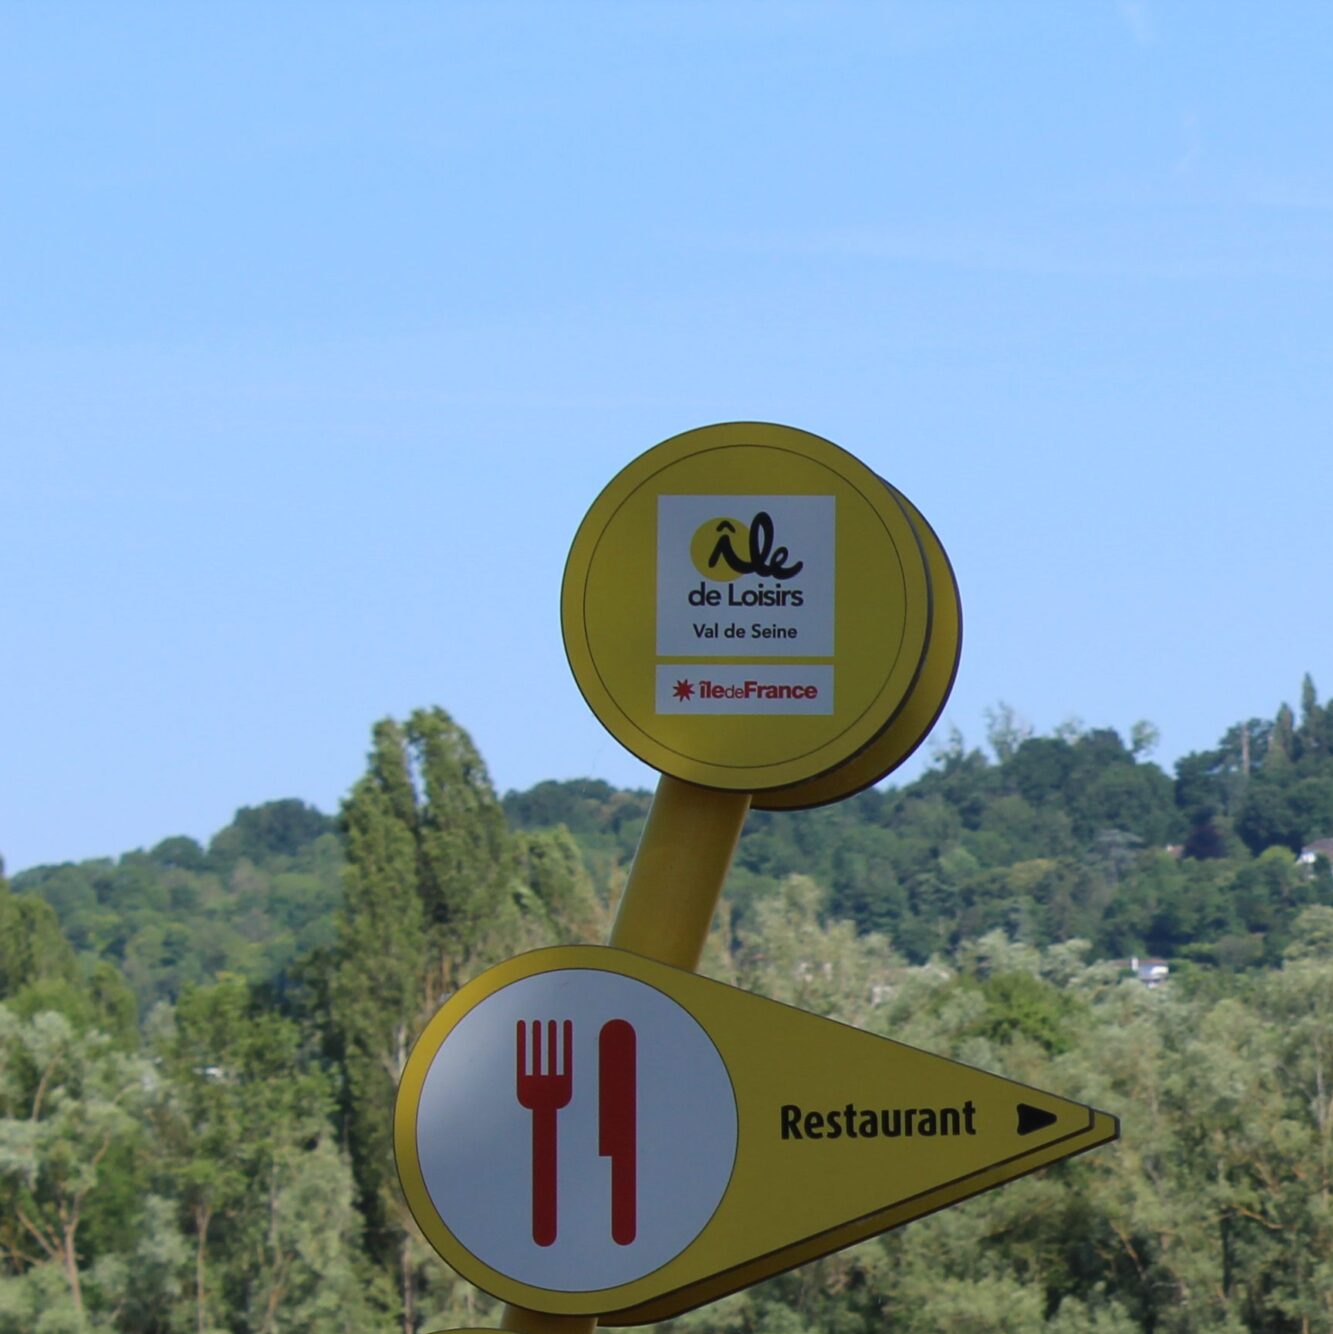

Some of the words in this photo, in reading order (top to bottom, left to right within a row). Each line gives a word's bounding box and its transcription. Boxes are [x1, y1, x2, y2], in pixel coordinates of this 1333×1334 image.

[709, 511, 804, 580] île
[688, 582, 721, 606] de
[729, 583, 804, 607] Loisirs
[693, 623, 719, 639] Val
[724, 623, 746, 639] de
[751, 623, 798, 639] Seine
[780, 1100, 976, 1140] Restaurant
